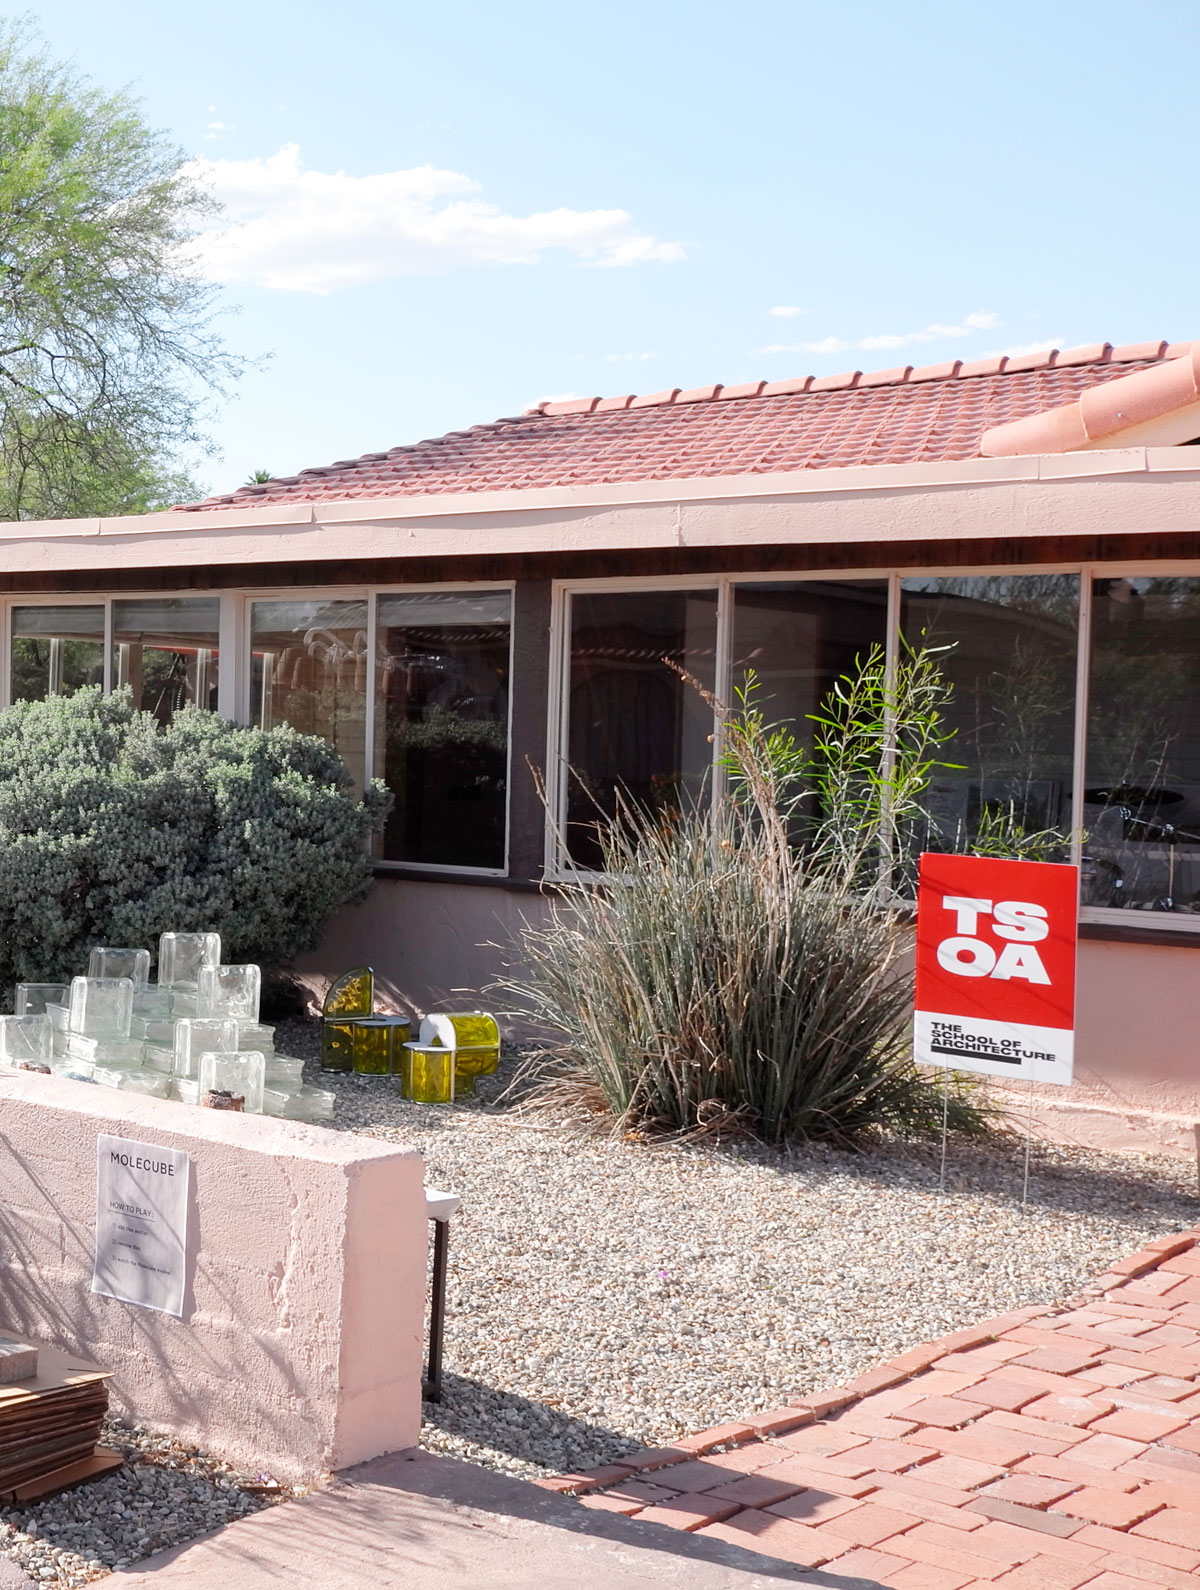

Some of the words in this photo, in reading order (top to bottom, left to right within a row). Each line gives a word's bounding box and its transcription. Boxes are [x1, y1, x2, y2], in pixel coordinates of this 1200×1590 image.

[942, 895, 1050, 942] TS
[936, 936, 1053, 986] OA
[931, 1022, 962, 1033] THE
[931, 1030, 998, 1046] SCHOOL
[1000, 1039, 1022, 1048] OF
[930, 1038, 1056, 1062] ARCHITECTURE
[110, 1152, 175, 1177] MOLECUBE
[109, 1201, 124, 1210] HOW
[126, 1204, 135, 1213] TO
